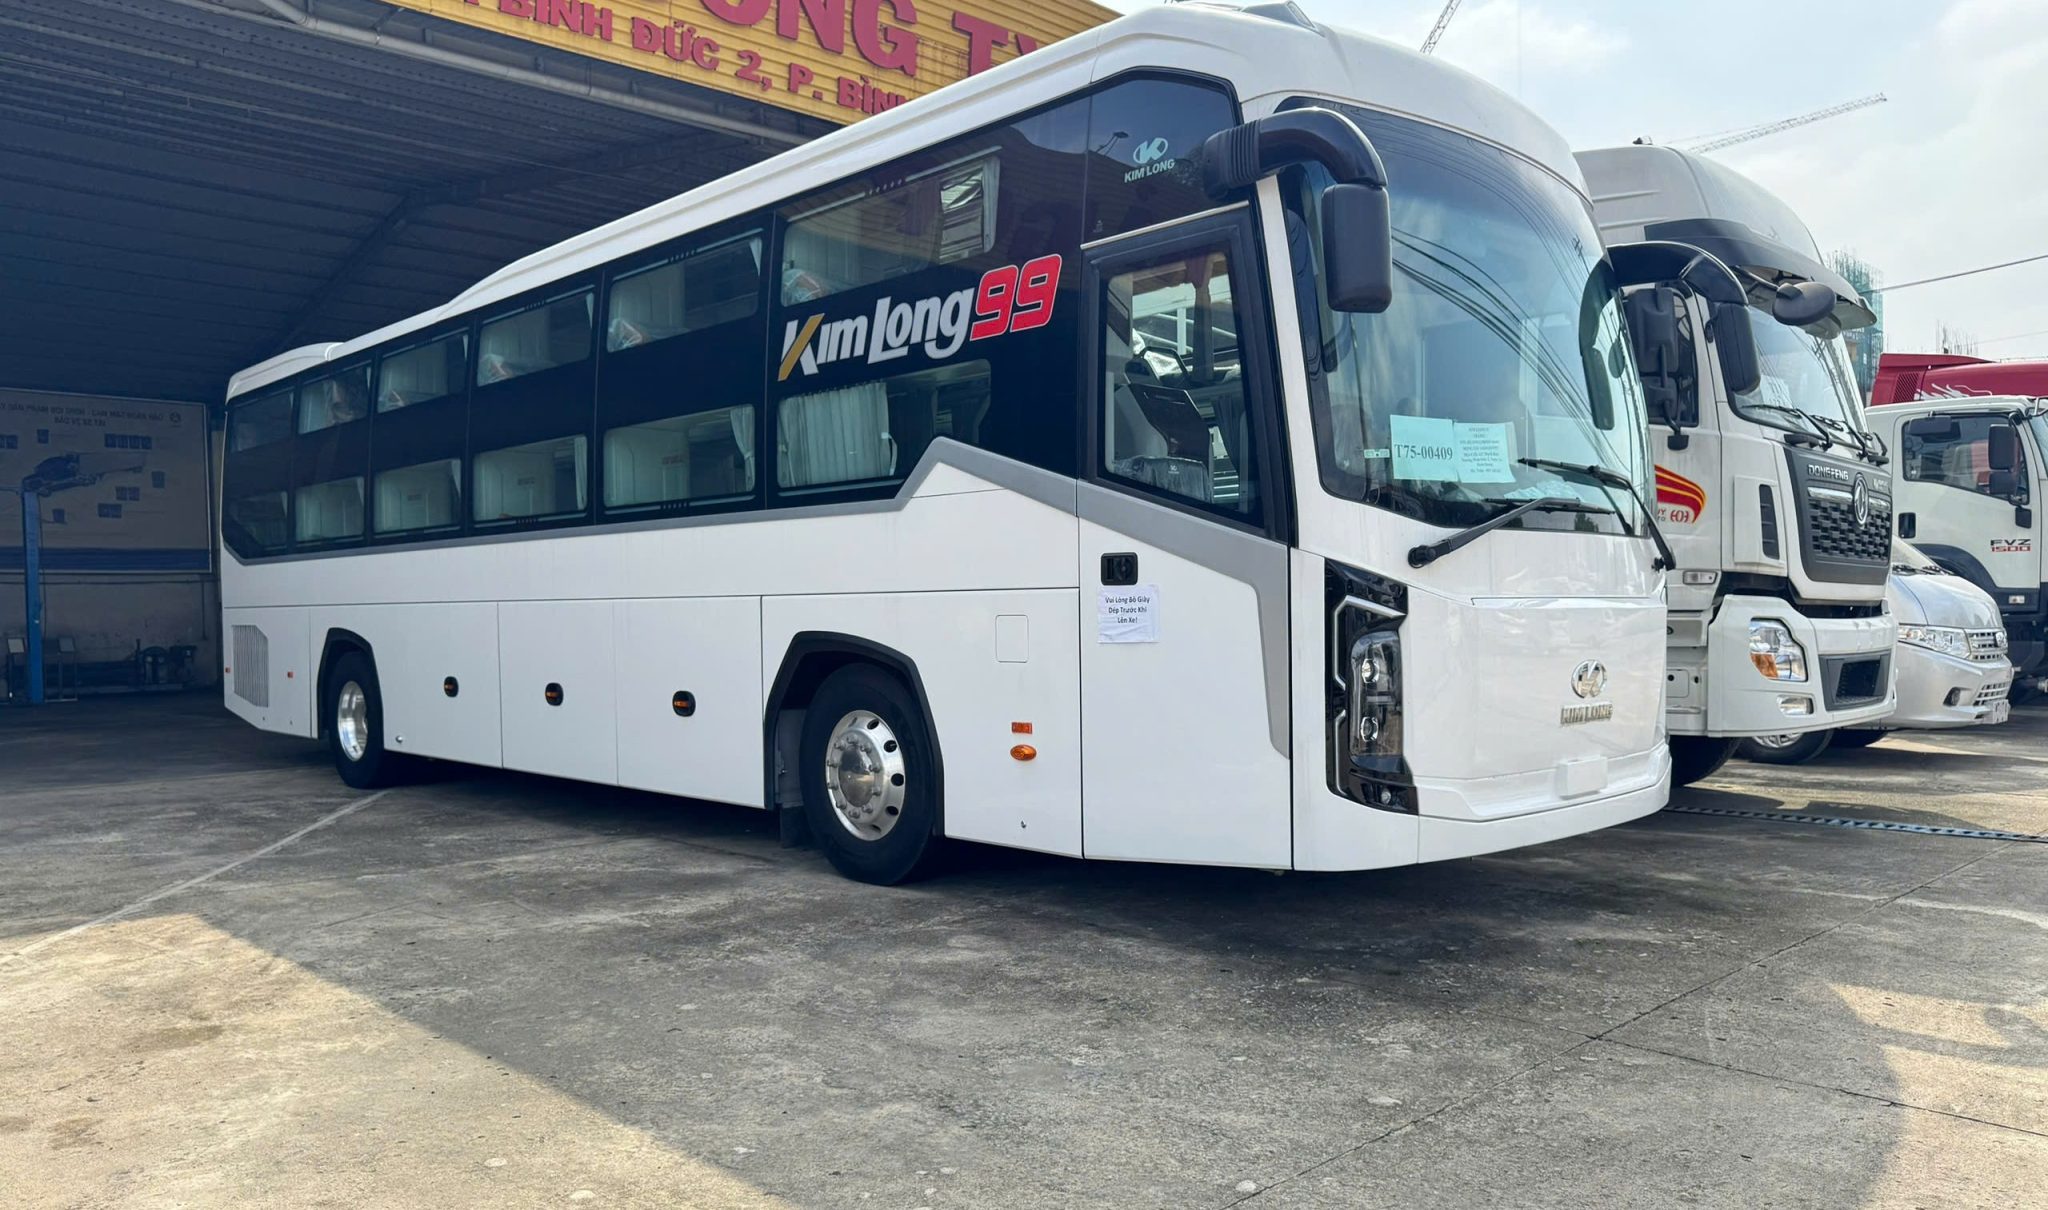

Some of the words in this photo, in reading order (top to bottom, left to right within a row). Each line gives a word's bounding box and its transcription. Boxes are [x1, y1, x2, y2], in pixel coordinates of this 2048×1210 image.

[953, 12, 1037, 77] T
[735, 49, 773, 92] 2,
[787, 62, 823, 100] P.
[836, 75, 914, 117] BÌN
[1124, 167, 1145, 183] KIM
[1146, 158, 1176, 177] LONG
[1394, 444, 1453, 460] T75-00409
[1990, 538, 2031, 546] FVZ
[1105, 596, 1115, 604] Vui
[1108, 606, 1120, 614] Dép
[1137, 605, 1147, 613] Khi
[1117, 616, 1128, 624] Lên
[1128, 616, 1138, 624] Xe!
